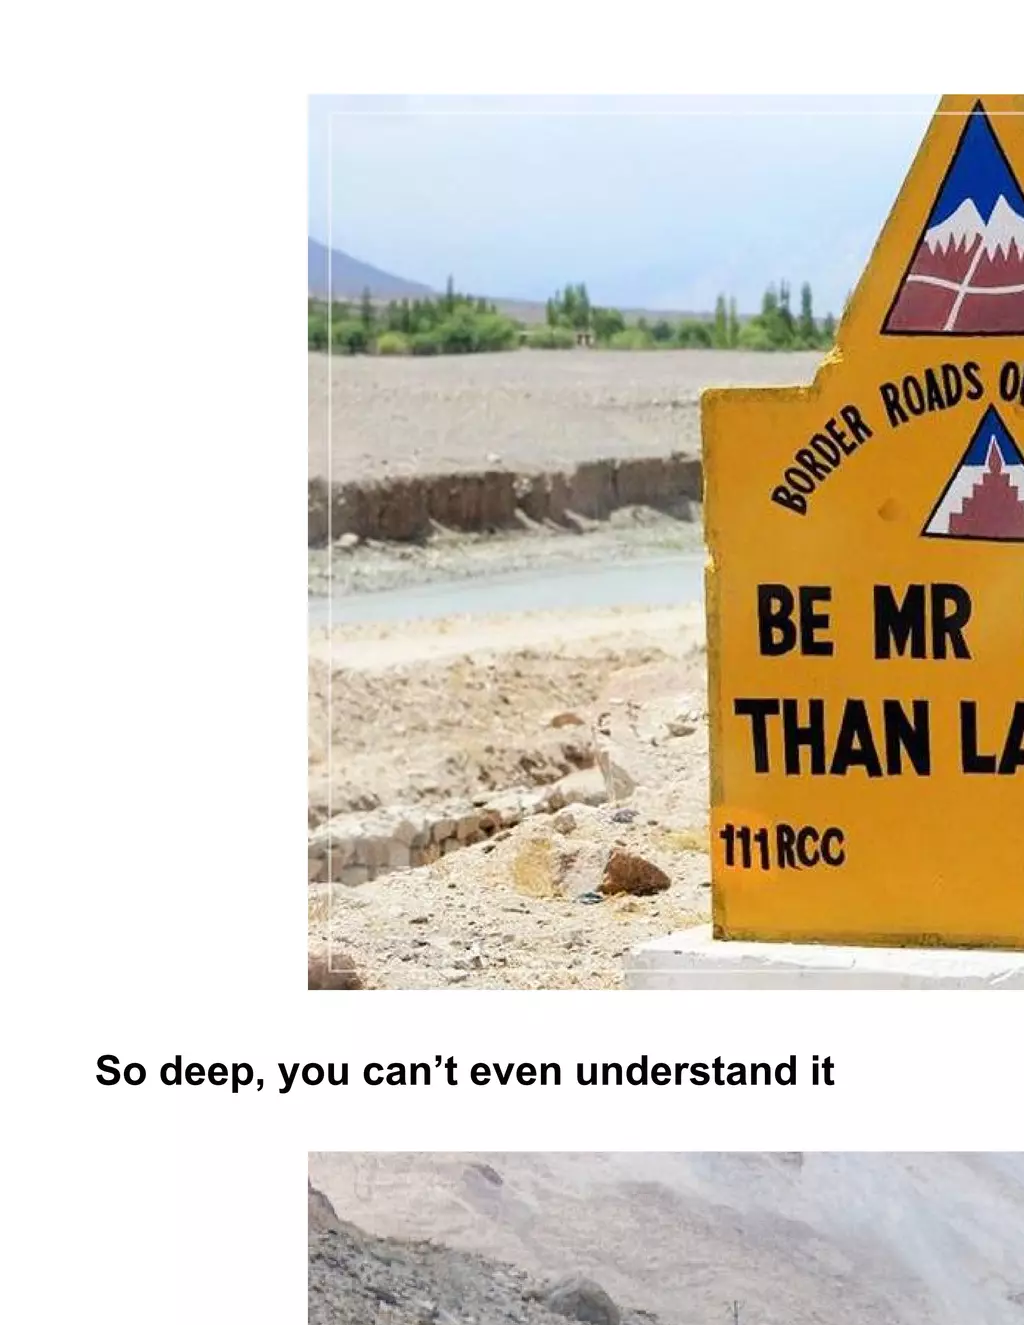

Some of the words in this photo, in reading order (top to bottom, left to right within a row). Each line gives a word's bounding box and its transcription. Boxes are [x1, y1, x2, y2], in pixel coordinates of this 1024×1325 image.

[771, 404, 873, 516] BORDER
[879, 361, 984, 428] ROADS
[757, 584, 834, 656] BE
[873, 584, 972, 660] MR
[734, 698, 930, 776] THAN
[96, 1054, 147, 1086] So
[160, 1054, 264, 1094] deep,
[277, 1062, 349, 1094] you
[470, 1062, 561, 1086] even
[576, 1054, 797, 1086] understand
[812, 1054, 835, 1086] it
